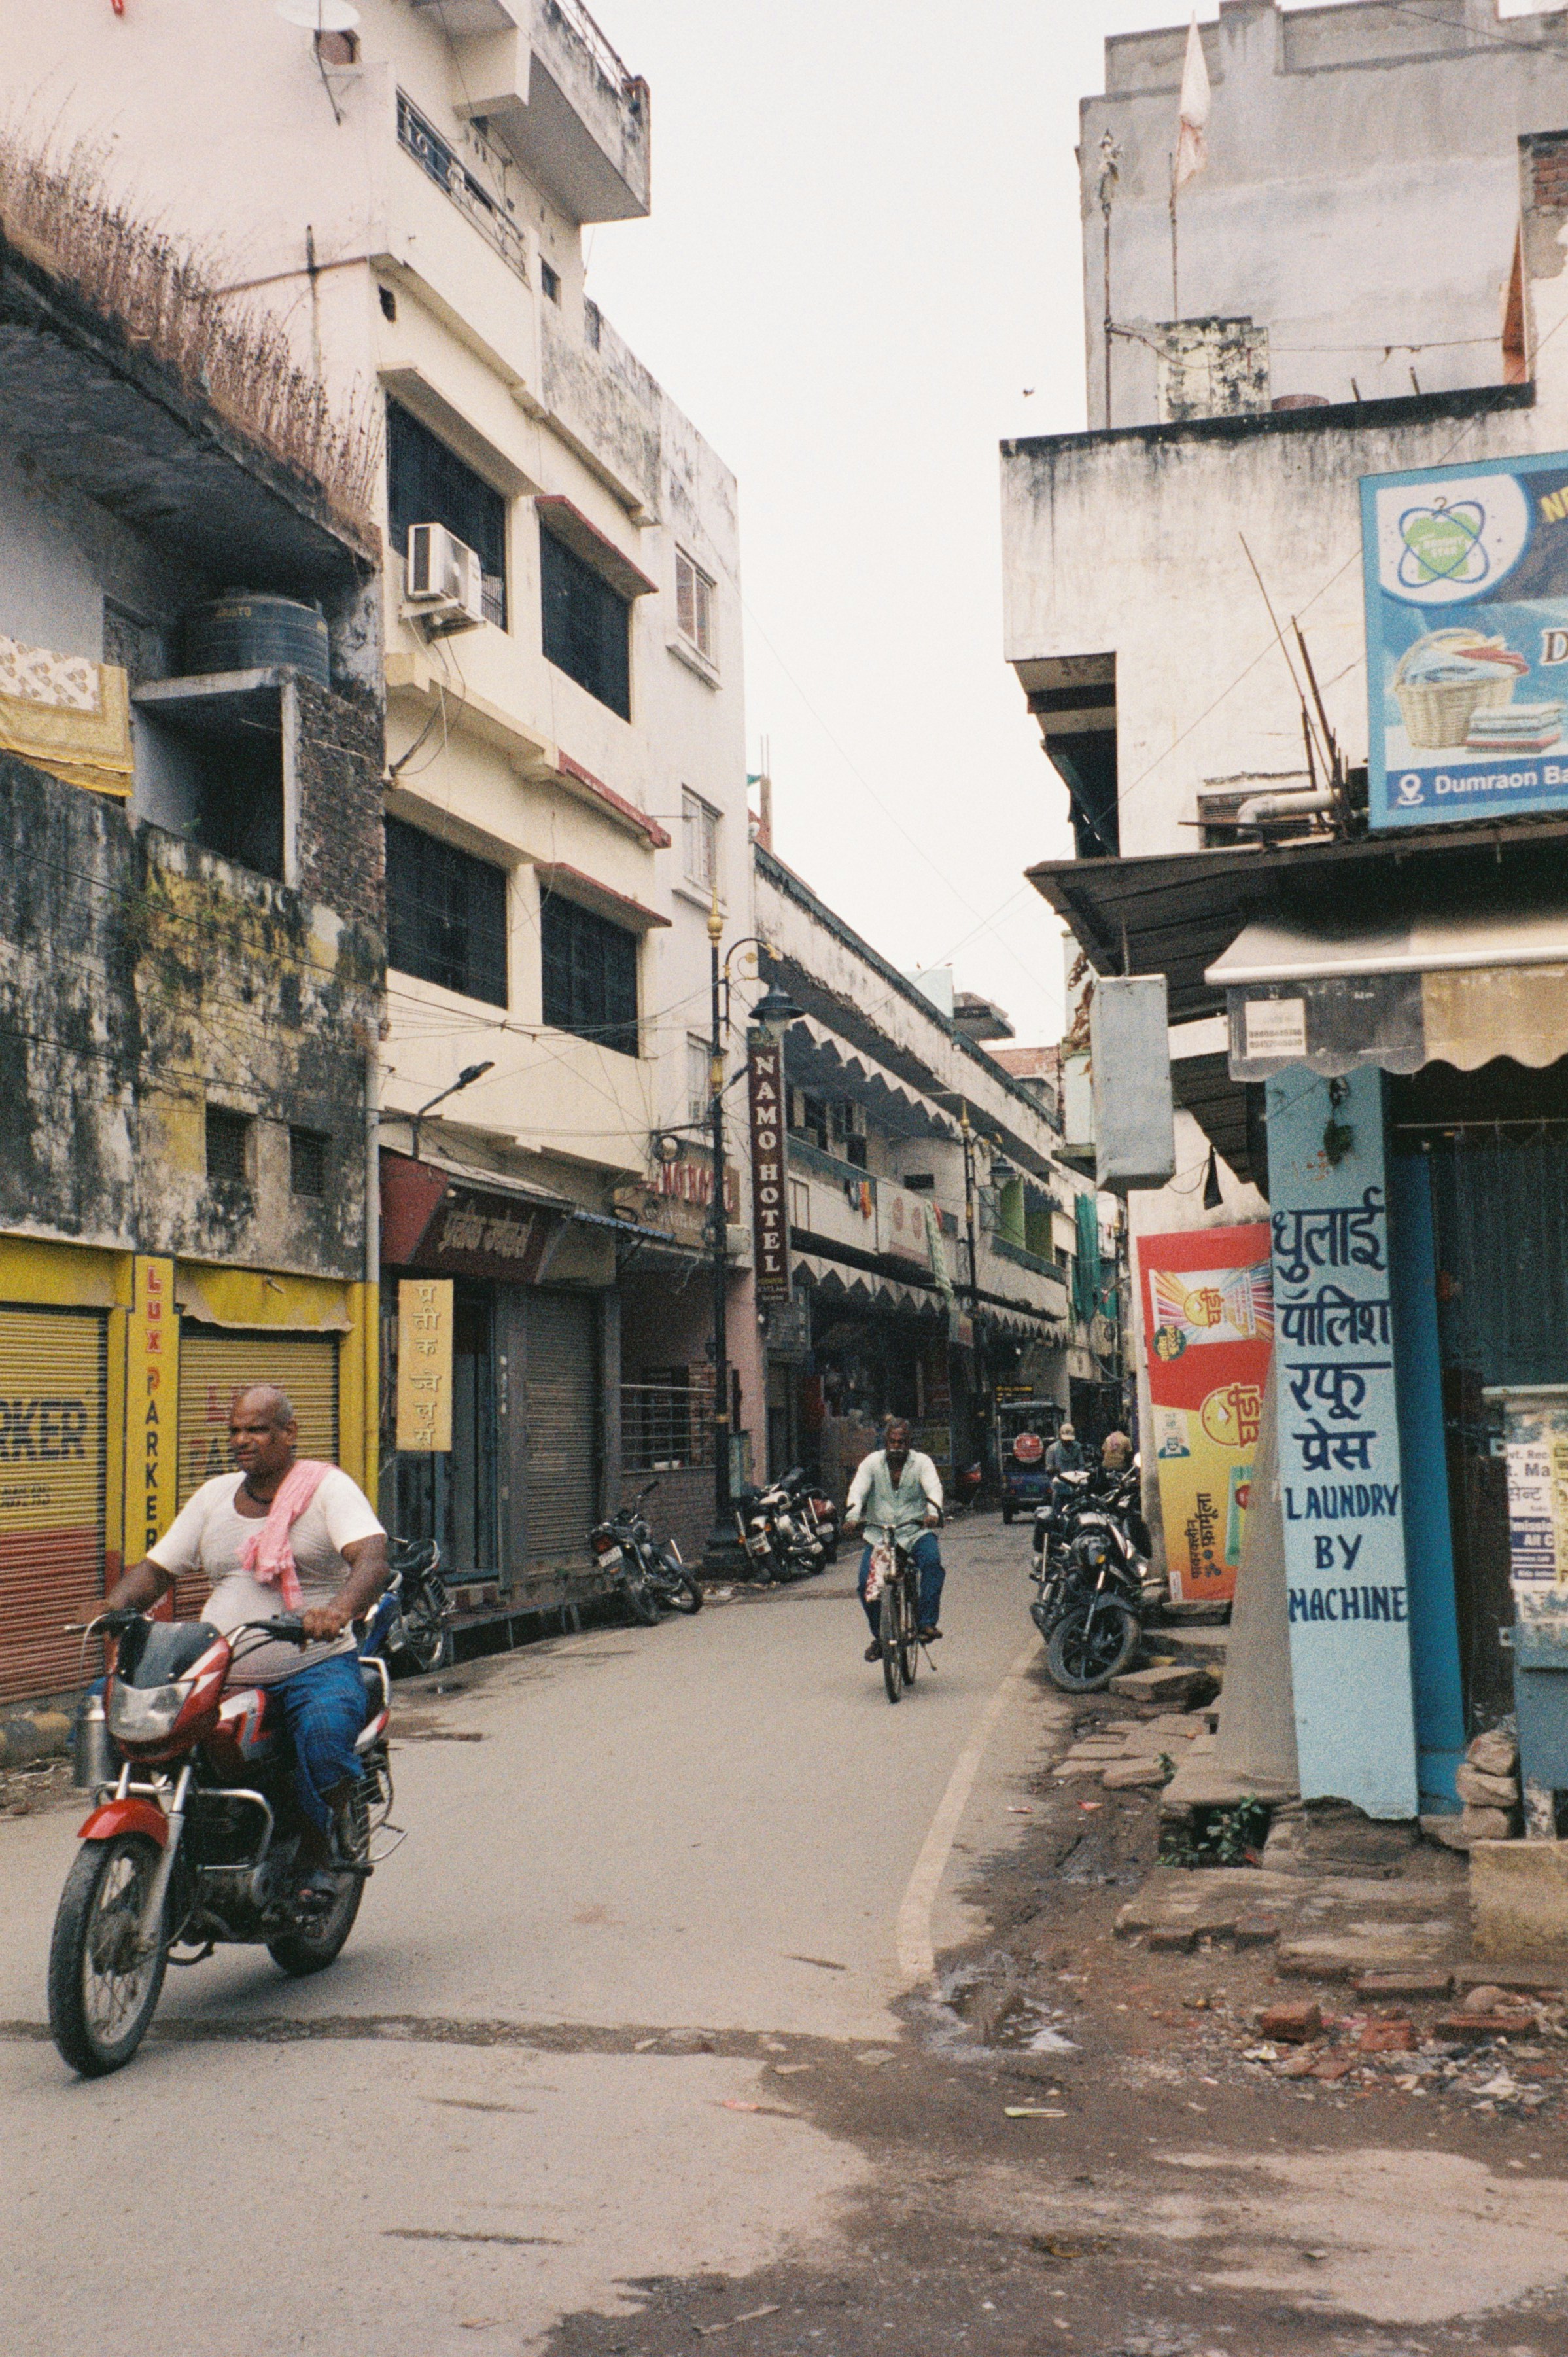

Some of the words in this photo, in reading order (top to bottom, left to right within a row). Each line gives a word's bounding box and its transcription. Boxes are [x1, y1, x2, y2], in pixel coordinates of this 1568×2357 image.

[1435, 771, 1537, 794] Dumraon
[755, 1056, 777, 1150] NAMO
[760, 1164, 780, 1272] HOTEL
[1273, 1186, 1385, 1283] धुलाई
[145, 1266, 162, 1353] LUX
[413, 1286, 441, 1357] प्रतीक
[1200, 1287, 1225, 1328] घड़ी
[1277, 1285, 1391, 1347] पॉलिश
[1285, 1361, 1392, 1419] रफू
[145, 1366, 161, 1555] PARKER
[1292, 1419, 1376, 1470] प्रेस
[1507, 1450, 1523, 1459] vt.
[1285, 1484, 1400, 1521] LAUNDRY
[1315, 1534, 1363, 1570] BY
[1289, 1587, 1408, 1622] MACHINE
